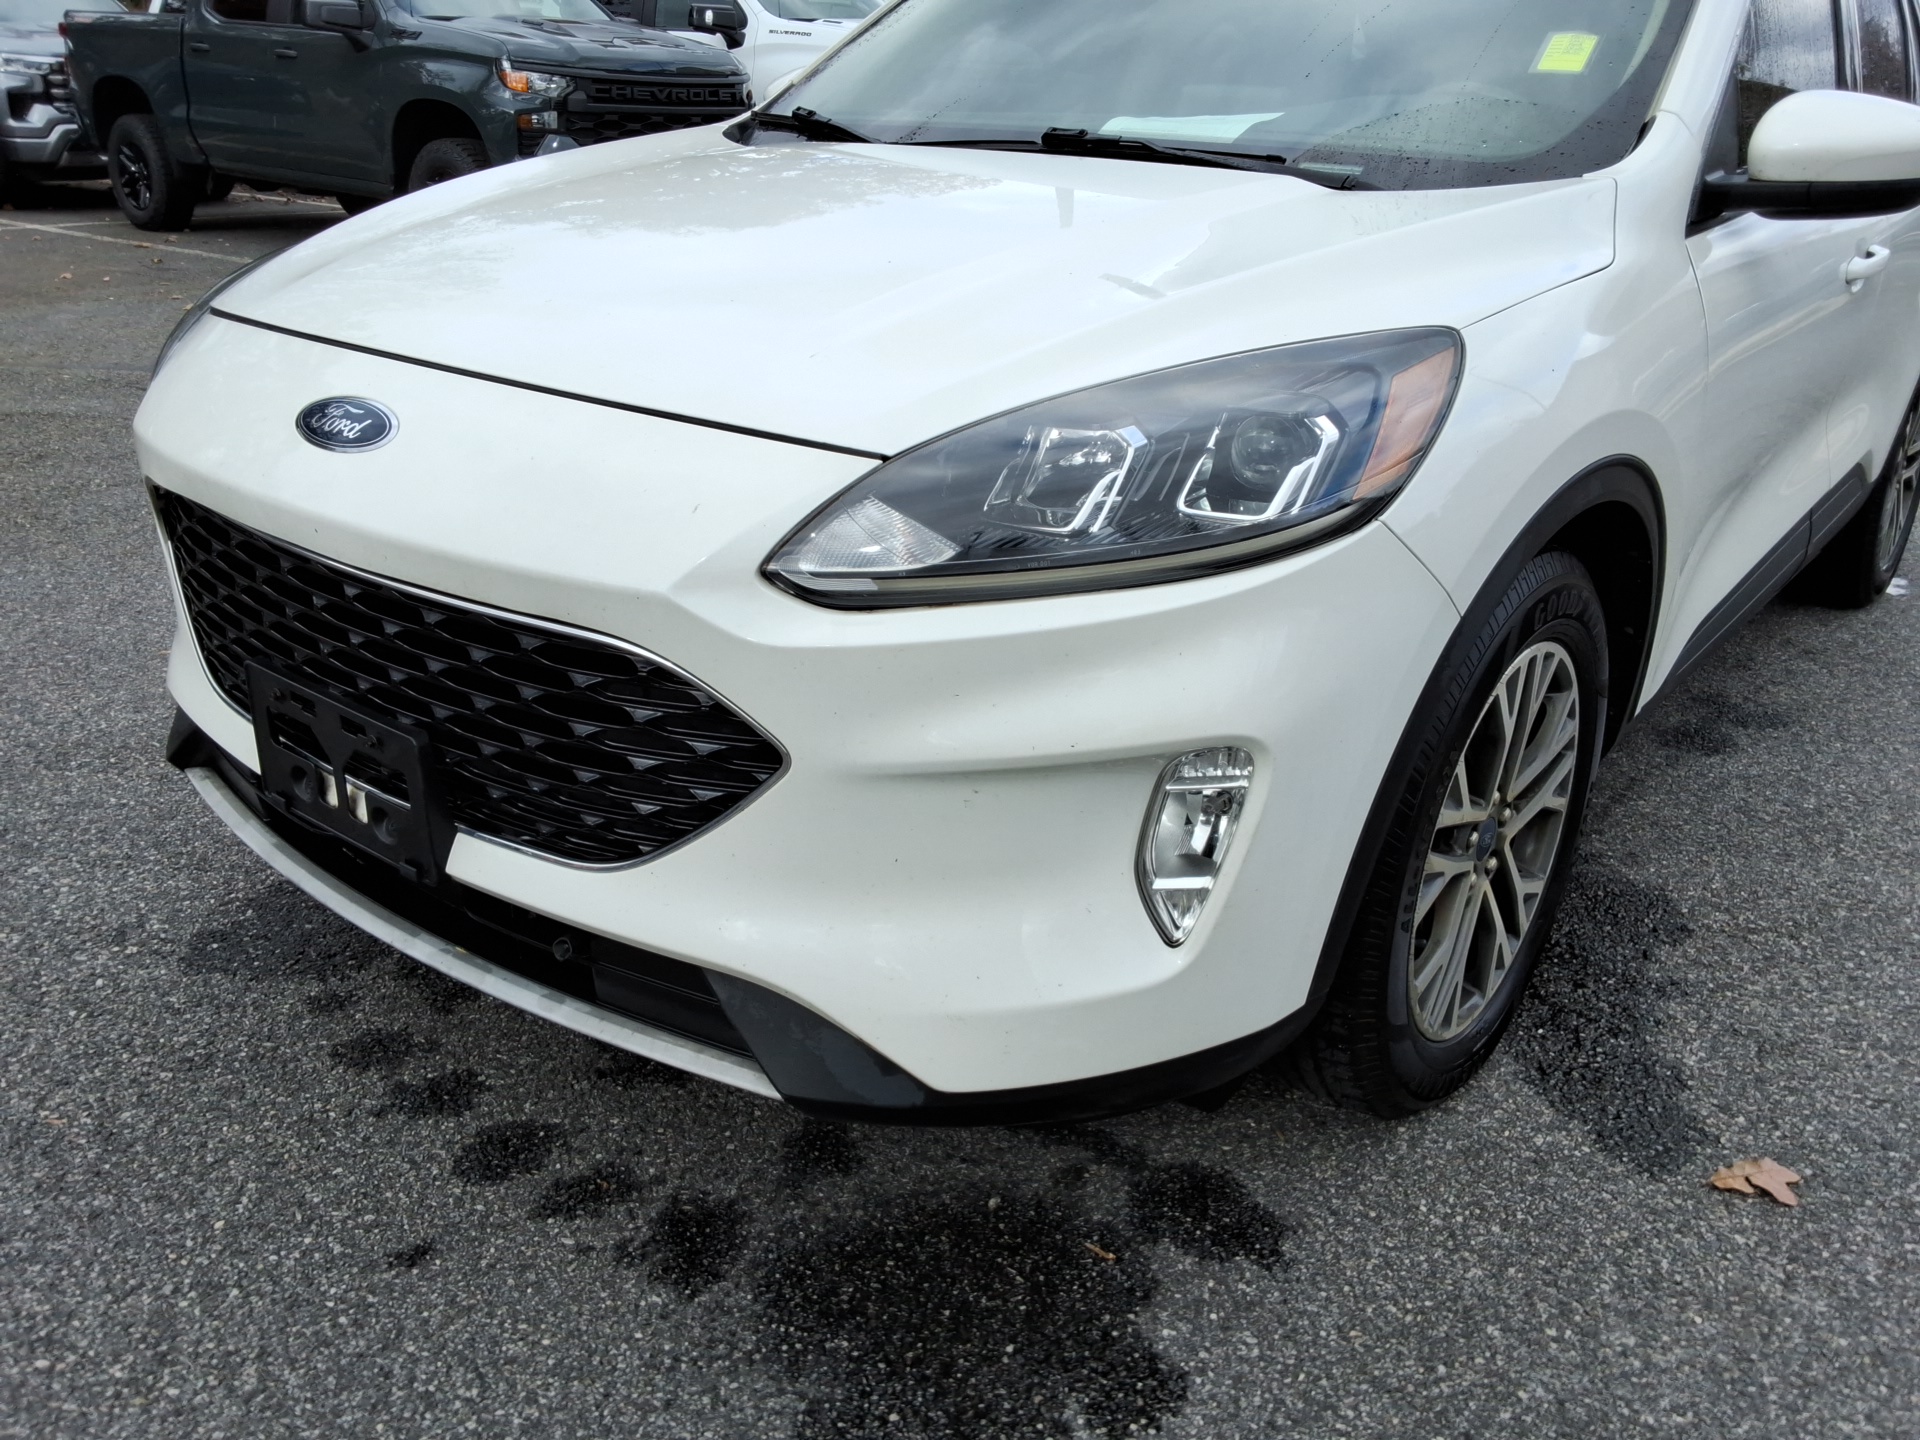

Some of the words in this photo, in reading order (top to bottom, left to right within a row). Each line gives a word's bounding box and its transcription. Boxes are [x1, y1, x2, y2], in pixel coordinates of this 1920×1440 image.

[768, 29, 812, 37] SILVERADO
[591, 84, 744, 102] CHEVROLET
[311, 403, 372, 439] Ford
